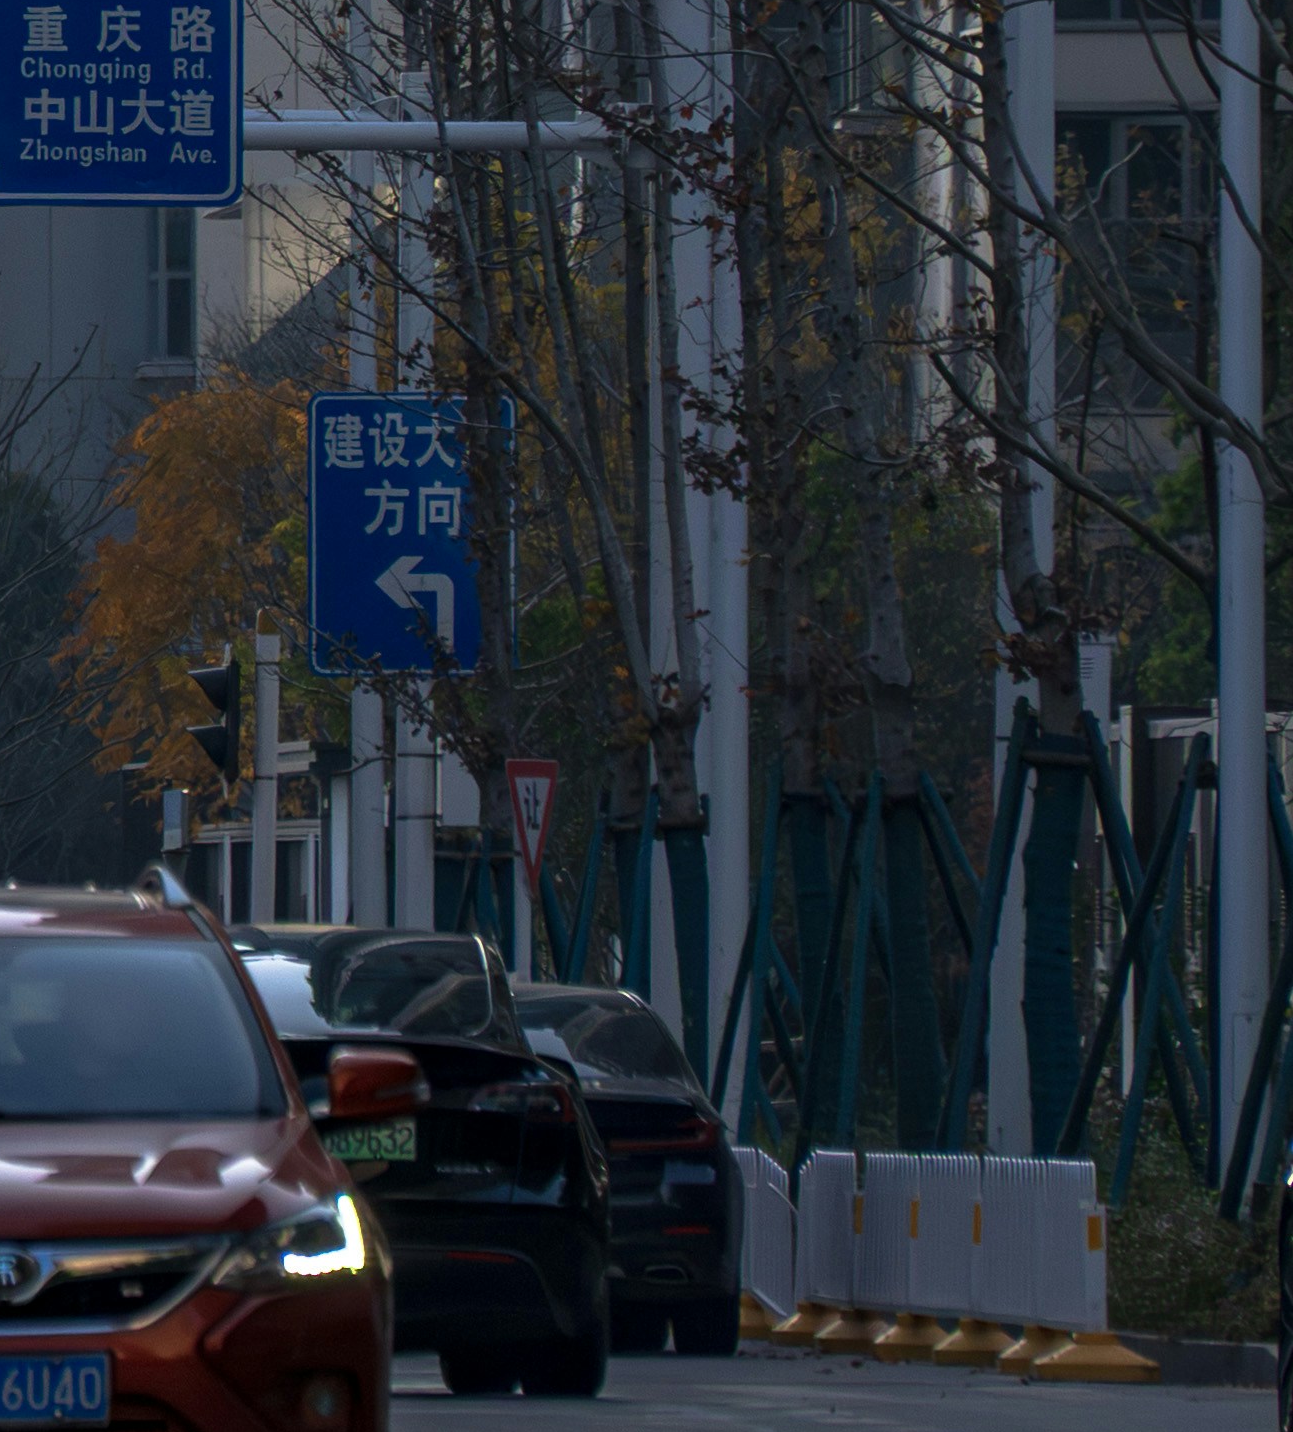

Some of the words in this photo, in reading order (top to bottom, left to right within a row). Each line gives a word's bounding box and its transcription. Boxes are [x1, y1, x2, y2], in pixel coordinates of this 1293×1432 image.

[23, 5, 215, 53] 重庆路
[21, 57, 152, 84] Chongqing
[174, 57, 212, 79] Rd.
[23, 89, 215, 136] 中山大道
[20, 139, 147, 166] Zhongshan
[170, 142, 217, 164] Ave.
[324, 413, 455, 469] 建设大
[364, 480, 462, 537] 方向
